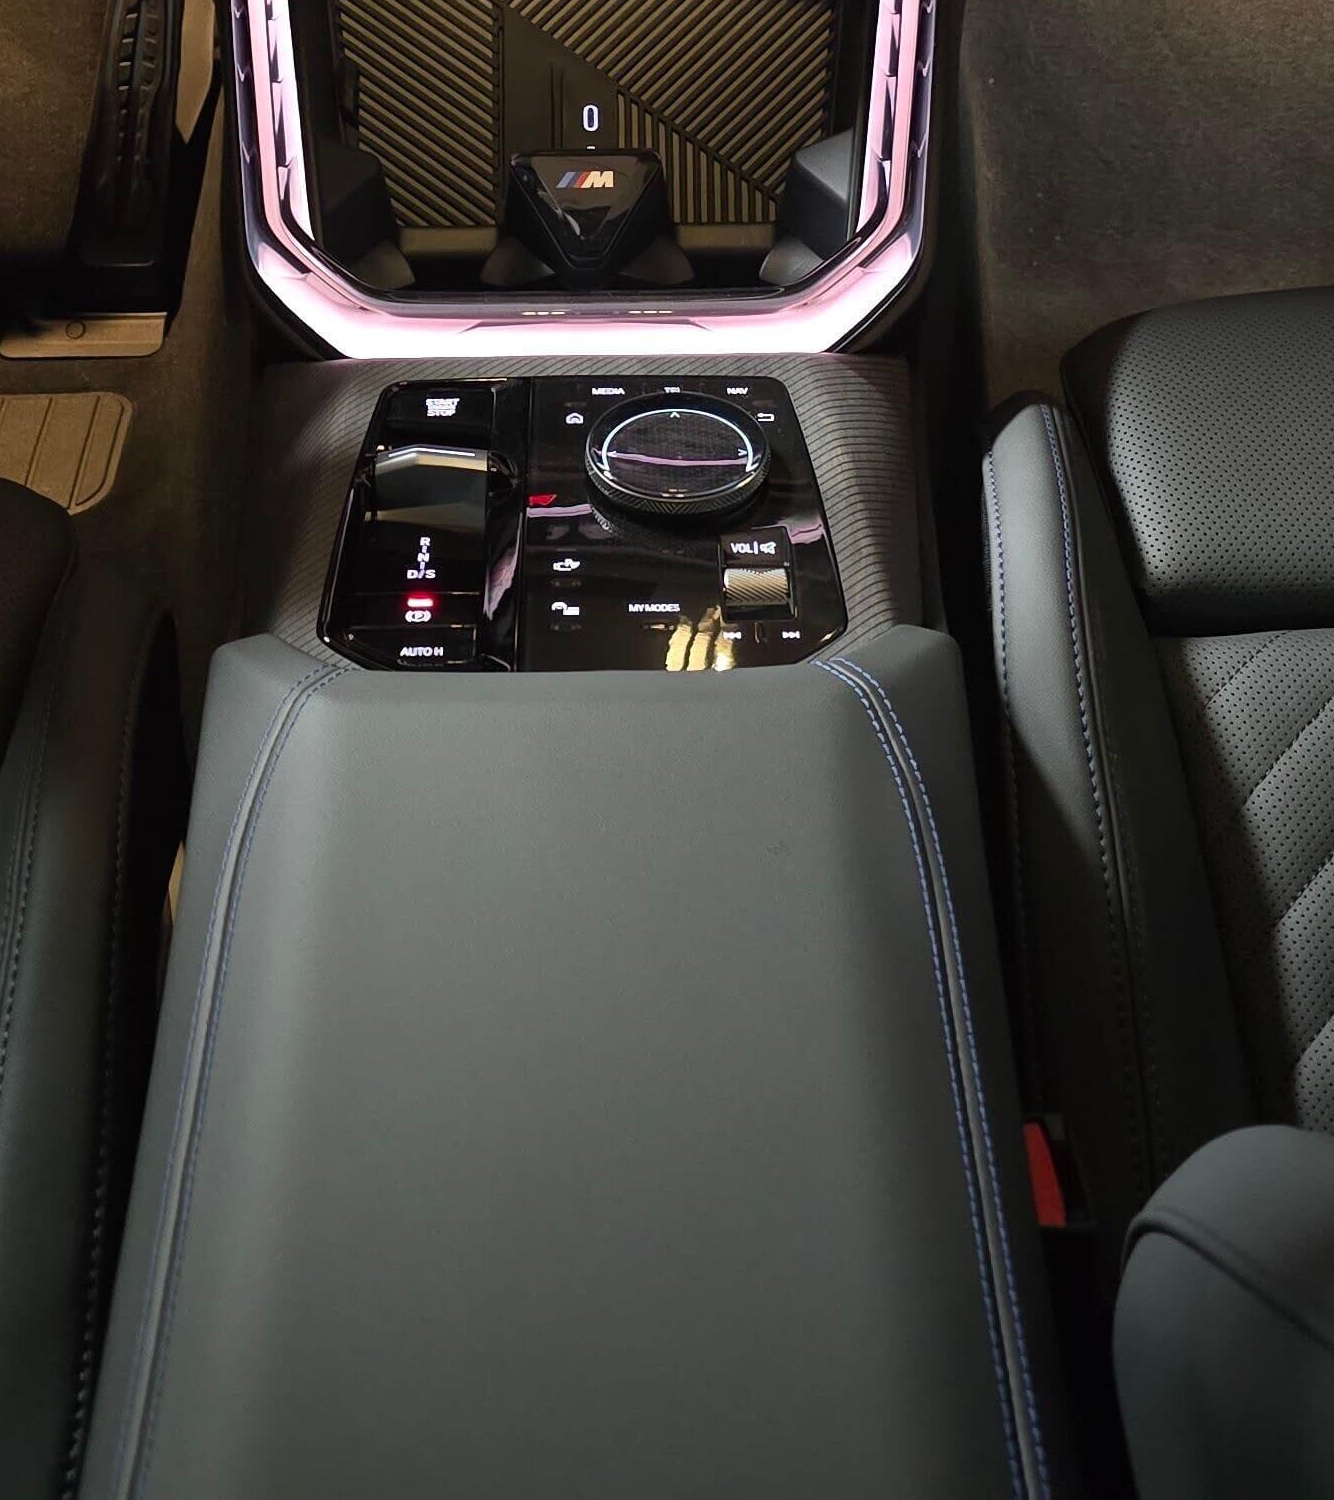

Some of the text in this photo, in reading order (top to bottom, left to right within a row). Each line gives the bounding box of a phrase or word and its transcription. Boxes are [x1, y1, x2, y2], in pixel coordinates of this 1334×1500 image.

[580, 170, 614, 188] M
[591, 387, 625, 395] MEDIA
[726, 387, 749, 395] NAV
[419, 536, 431, 546] R
[730, 542, 753, 554] VOL
[417, 552, 430, 563] N
[406, 569, 436, 579] D/S
[399, 646, 444, 657] AUTO H
